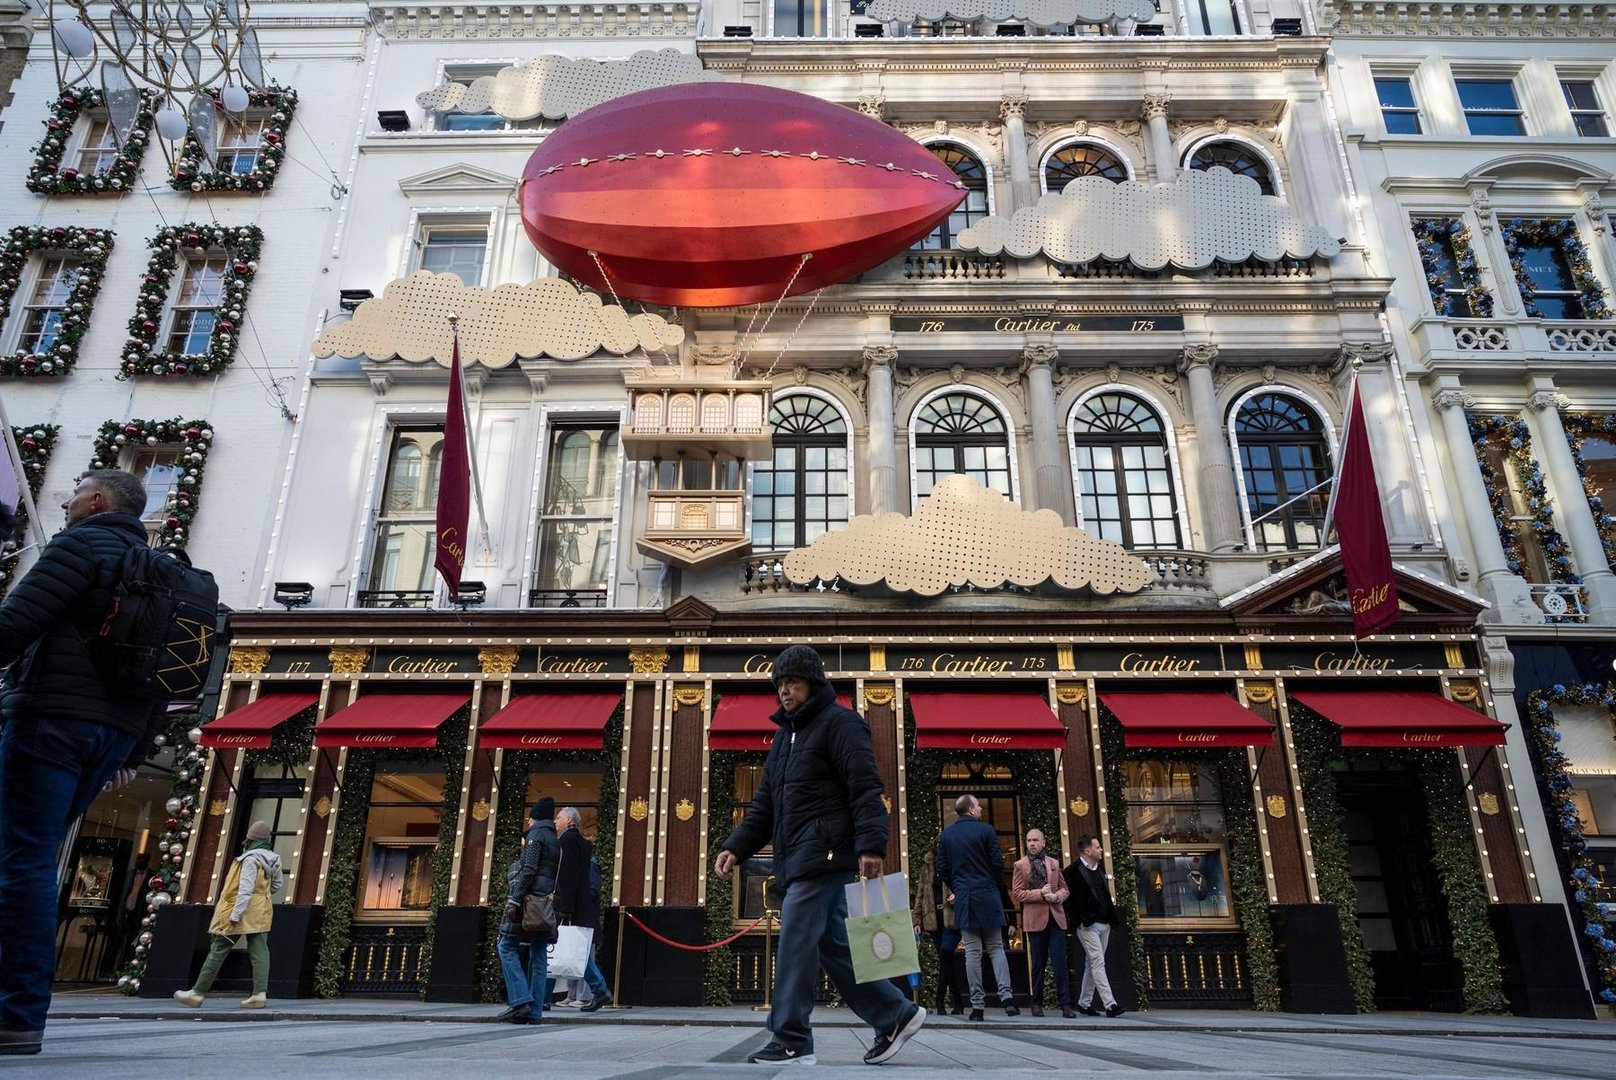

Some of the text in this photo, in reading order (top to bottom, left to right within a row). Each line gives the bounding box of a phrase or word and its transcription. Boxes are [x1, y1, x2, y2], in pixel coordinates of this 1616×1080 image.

[920, 321, 945, 332] 176
[995, 317, 1060, 331] Cartier
[1131, 320, 1155, 331] 175
[1353, 582, 1391, 614] Cartier
[286, 661, 311, 673] 177
[388, 655, 458, 673] Cartier
[539, 655, 608, 673] Cartier
[901, 653, 1046, 672] 176 Cartier 175
[1120, 652, 1200, 672] Cartier
[1314, 651, 1395, 671] Cartier
[216, 732, 257, 743] Cartier
[355, 732, 396, 742] Cartier
[521, 733, 562, 744] Cartier
[970, 732, 1012, 744] Cartier
[1178, 731, 1218, 742] Cartier
[1403, 731, 1444, 742] Cartier
